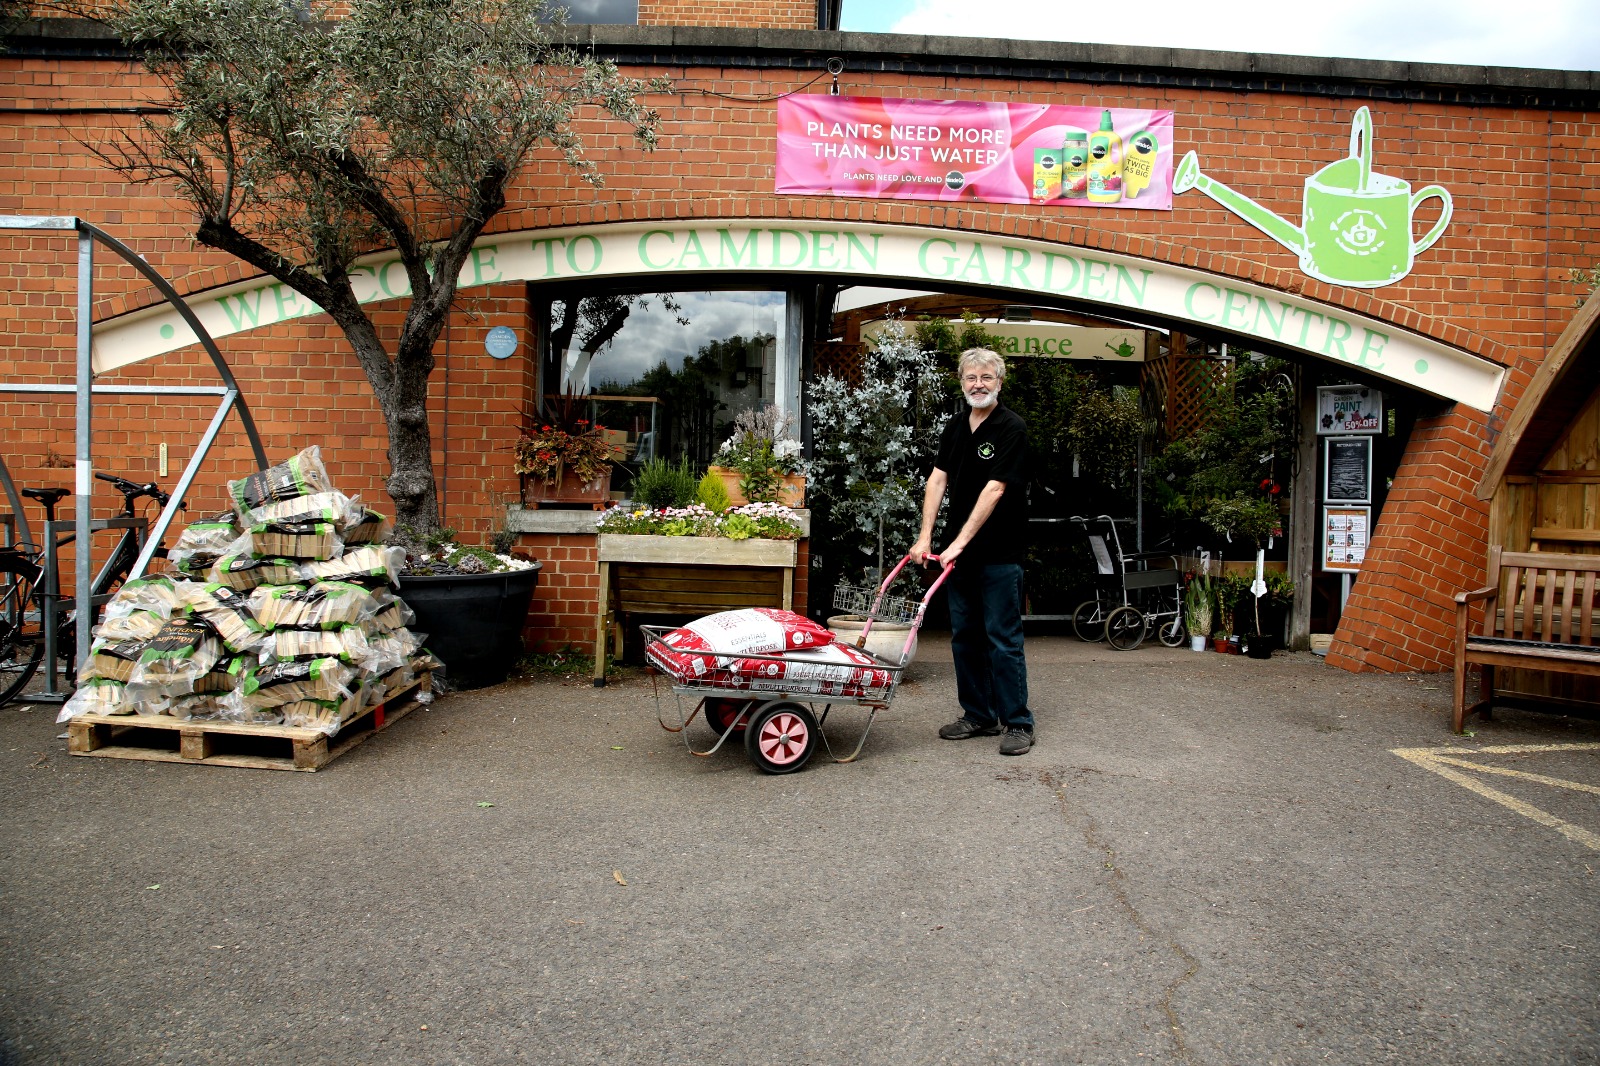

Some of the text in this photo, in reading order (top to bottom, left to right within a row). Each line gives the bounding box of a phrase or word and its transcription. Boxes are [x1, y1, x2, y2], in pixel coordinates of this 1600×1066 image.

[807, 121, 1005, 145] PLANTS NEED MORE
[811, 142, 999, 166] THAN JUST WATER
[1124, 166, 1149, 178] AS BIG
[1127, 158, 1151, 172] TWICE
[843, 172, 875, 181] PLANTS
[877, 173, 899, 182] NEED
[901, 174, 922, 183] LOVE
[924, 175, 943, 184] AND
[217, 228, 1390, 371] WECOE TO CAMDEN GARDEN CENTRE
[1334, 401, 1362, 412] PAINT
[1345, 418, 1378, 430] 50% OFF
[731, 631, 767, 646] ESSENTIALS
